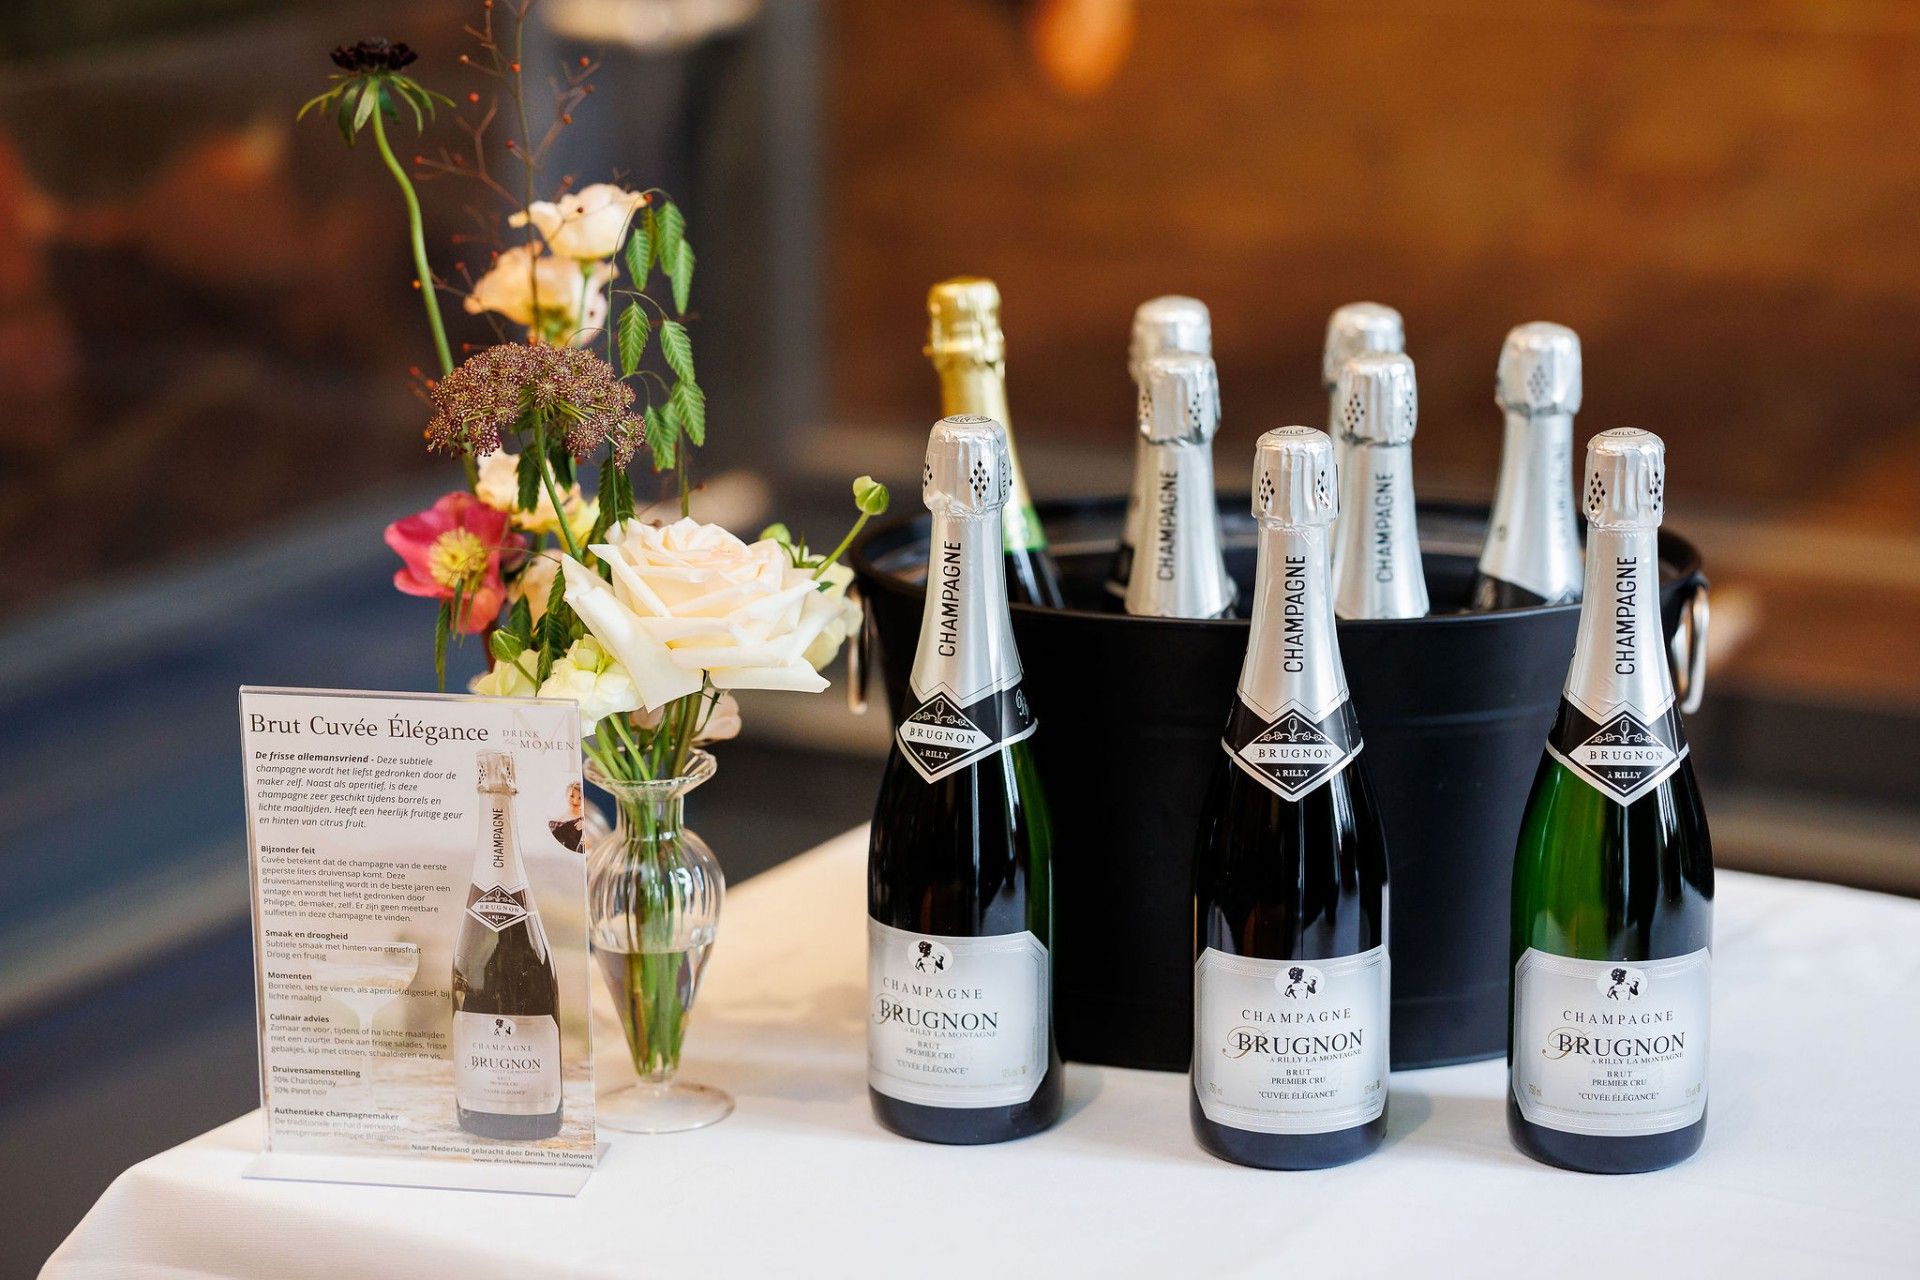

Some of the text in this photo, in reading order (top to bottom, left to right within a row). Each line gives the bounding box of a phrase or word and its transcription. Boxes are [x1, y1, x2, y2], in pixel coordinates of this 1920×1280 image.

[1157, 470, 1178, 582] CHAMPAGNE
[1375, 472, 1394, 584] CHAMPAGNE
[938, 540, 962, 657] CHAMPAGNE
[1284, 555, 1306, 673] CHAMPAGNE
[1615, 556, 1637, 676] CHAMPAGNE
[250, 713, 489, 746] Brut Cuvée Élégance
[502, 729, 540, 738] DRINK
[908, 726, 977, 745] BRUGNON
[255, 751, 433, 765] De frisse allemansvriend Deze subtiele
[919, 748, 950, 760] À RILLY
[1257, 748, 1332, 759] BRUGNON
[1589, 750, 1664, 761] BRUGNON
[256, 764, 457, 780] champagne wordt het liefst gedronken door de
[1275, 768, 1310, 777] À RILLY
[1607, 770, 1642, 780] À RILLY
[256, 778, 418, 791] maker zelf. Naast als aperitief, is deze
[257, 790, 308, 801] champagne
[330, 793, 365, 803] geschikt
[367, 794, 395, 804] tijdens
[398, 796, 428, 805] borrels
[258, 803, 281, 811] lichte
[283, 804, 332, 814] maaltijden.
[334, 806, 357, 816] Heeft
[377, 807, 408, 818] heerlijk
[410, 809, 441, 820] fruitige
[443, 812, 463, 820] geur
[272, 816, 299, 825] hinten
[301, 818, 317, 826] van
[319, 818, 344, 827] citrus
[344, 819, 366, 829] fruit.
[492, 808, 504, 868] CHAMPAGNE
[261, 845, 299, 854] Bijzonder
[287, 857, 320, 865] betekent
[322, 858, 335, 866] dat
[349, 860, 393, 869] champagne
[261, 867, 295, 875] geperste
[318, 869, 361, 878] druivensap
[391, 882, 412, 890] beste
[413, 884, 434, 892] jaren
[263, 888, 291, 897] vintage
[329, 890, 341, 898] het
[363, 892, 405, 900] gedronken
[479, 904, 519, 913] BRUGNON
[307, 932, 348, 940] droogheid
[267, 971, 312, 980] Momenten
[883, 977, 983, 1000] CHAMPAGNE
[270, 1013, 330, 1023] Culinair advies
[880, 999, 999, 1030] BRUGNON
[1242, 1007, 1351, 1024] CHAMPAGNE
[1563, 1010, 1673, 1025] CHAMPAGNE
[949, 1031, 996, 1039] MONTAGNE
[472, 1042, 533, 1051] CHAMPAGNE
[1238, 1029, 1363, 1055] BRUGNON
[1558, 1032, 1685, 1057] BRUGNON
[471, 1056, 541, 1069] BRUGNON
[1306, 1055, 1317, 1063] LA
[1319, 1049, 1362, 1062] MONTAGNE
[1641, 1052, 1683, 1064] MONTAGNE
[272, 1065, 360, 1078] Druivensamenstelling
[274, 1107, 399, 1120] Authentieke champagnemaker
[431, 1145, 470, 1153] Nederland
[471, 1147, 504, 1155] gebracht
[562, 1152, 593, 1160] Moment
